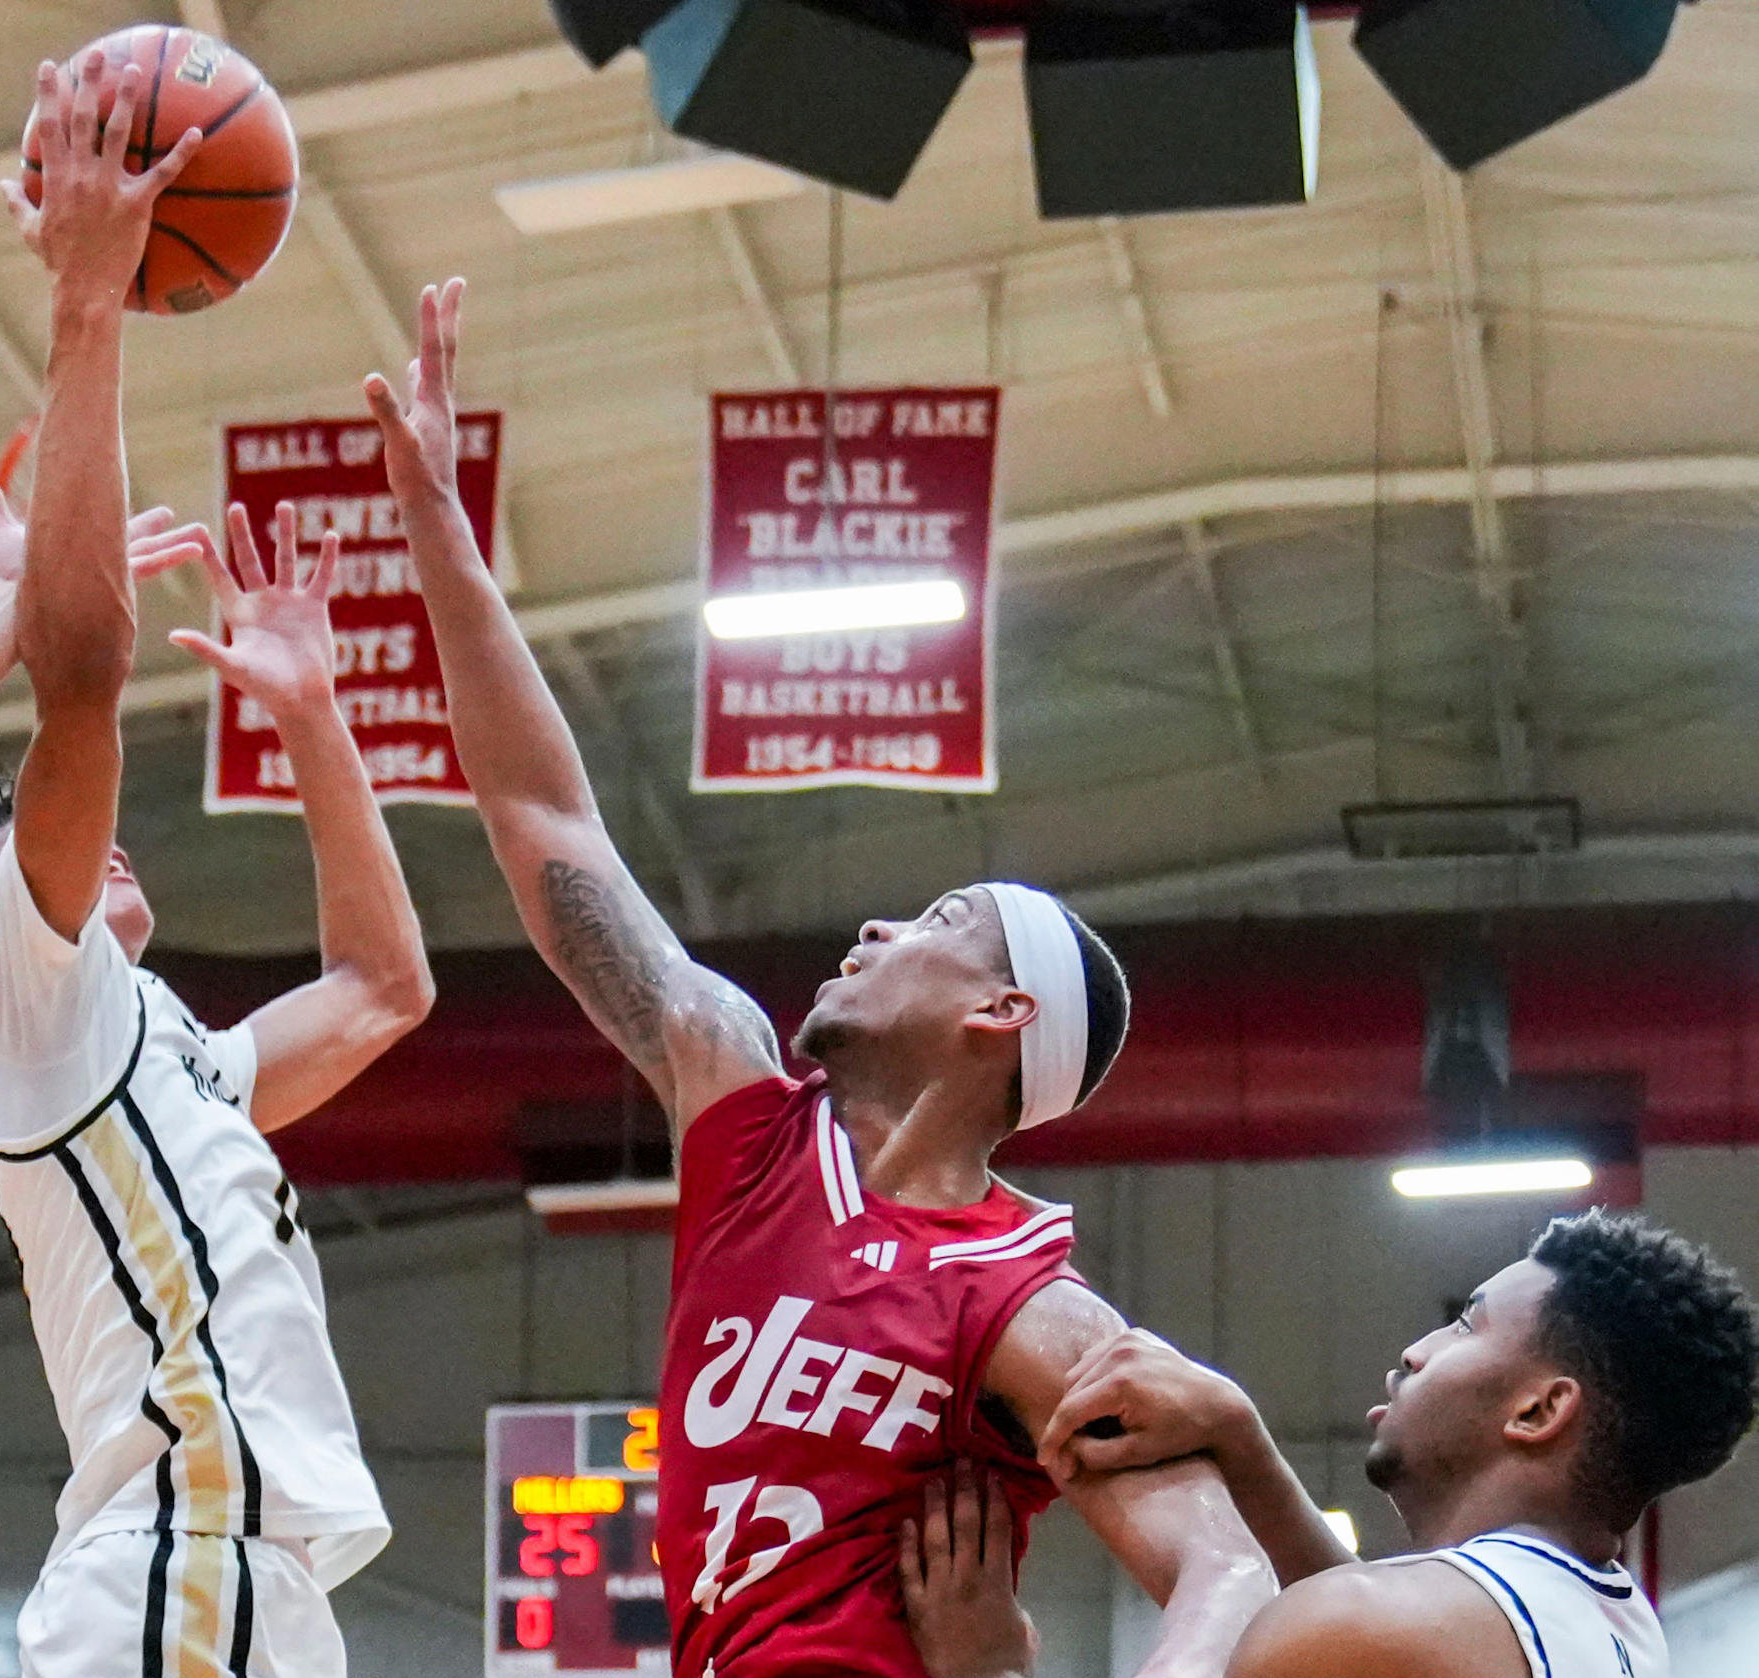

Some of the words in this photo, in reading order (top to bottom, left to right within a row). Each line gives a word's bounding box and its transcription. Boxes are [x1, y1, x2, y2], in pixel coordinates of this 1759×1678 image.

[721, 402, 820, 439] HALL
[833, 401, 881, 438] OF
[894, 399, 989, 437] FAME
[235, 427, 333, 474] HALL
[785, 458, 917, 504] CARL
[333, 623, 416, 678] OYS
[720, 678, 967, 717] BASKETBALL
[684, 1295, 954, 1452] JEFF
[519, 1512, 599, 1577] 25
[516, 1596, 553, 1650] 0
